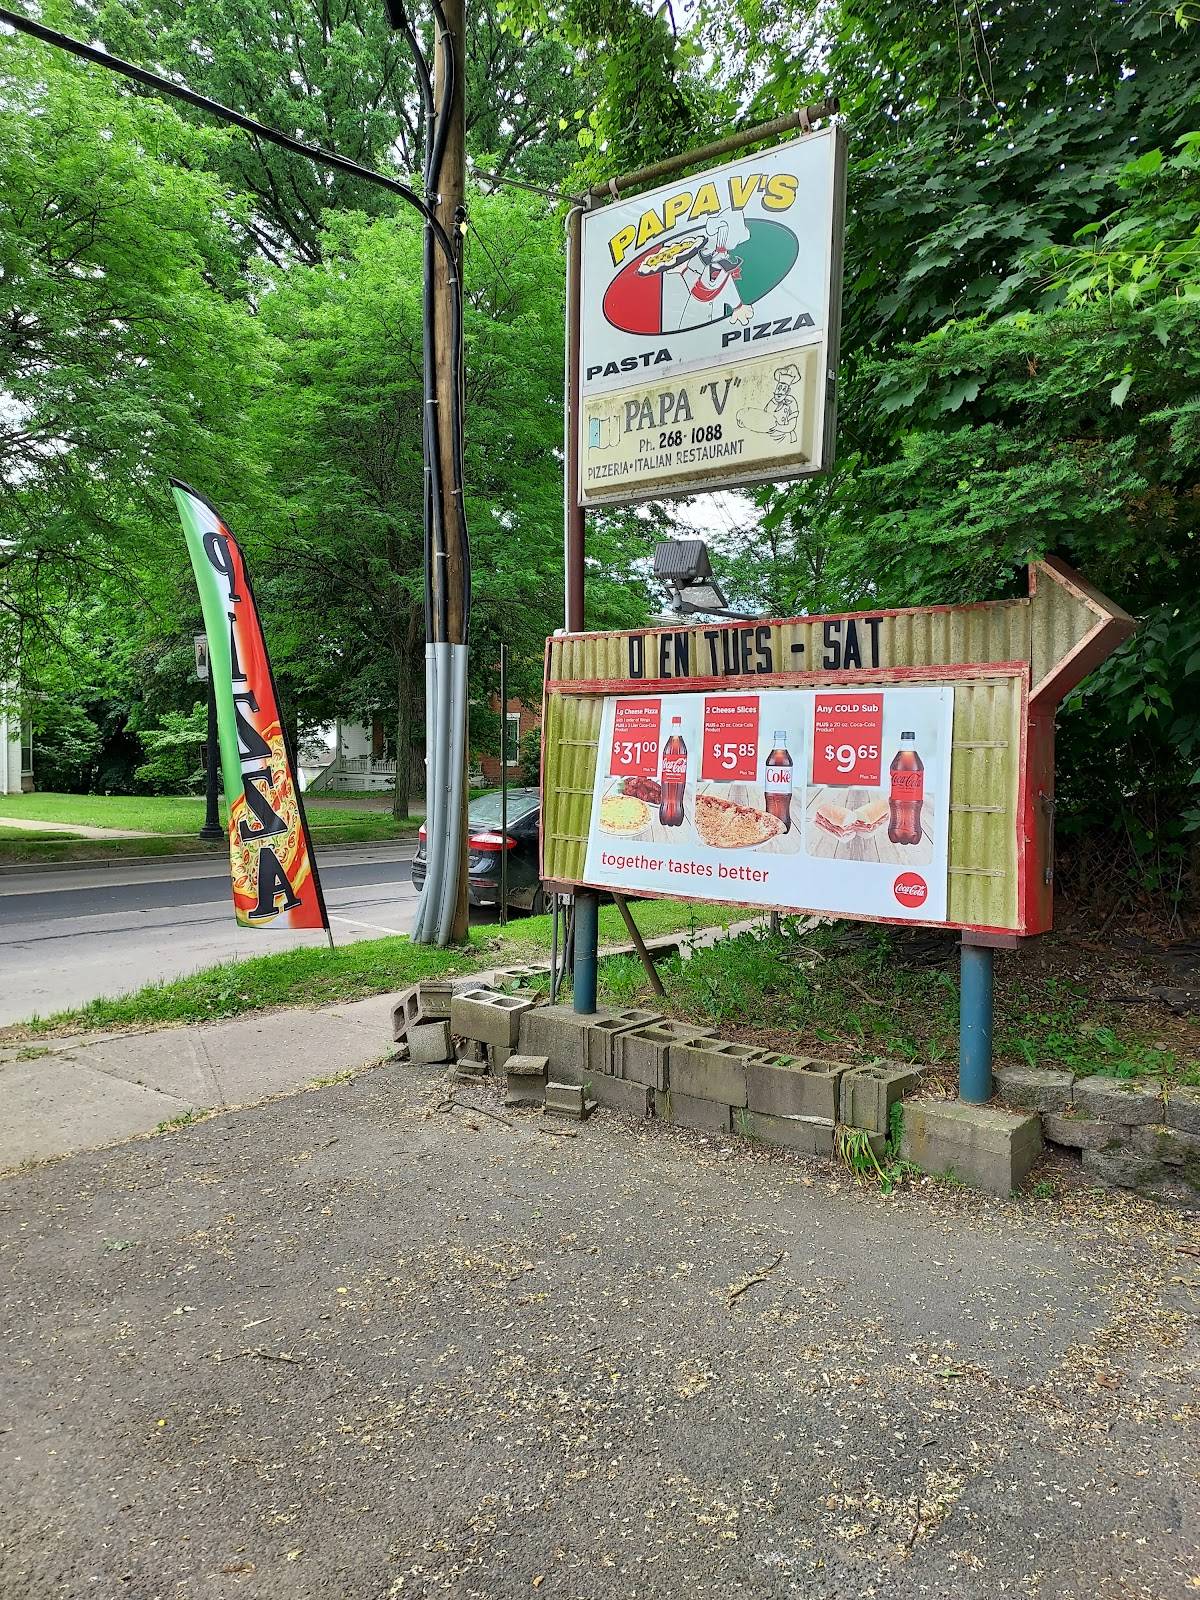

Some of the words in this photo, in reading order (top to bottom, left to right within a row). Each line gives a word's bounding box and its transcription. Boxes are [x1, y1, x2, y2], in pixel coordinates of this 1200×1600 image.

[608, 182, 722, 268] PAPA
[727, 173, 799, 213] V'S
[721, 312, 816, 348] PIZZA
[586, 348, 673, 381] PASTA
[623, 388, 694, 434] PAPA
[659, 423, 723, 449] 268-1088
[676, 439, 745, 465] RESTAURANT
[703, 625, 773, 677] TUES
[822, 616, 884, 671] SAT
[705, 706, 711, 714] 2
[711, 706, 736, 714] Cheese
[736, 705, 757, 714] Slices
[816, 704, 833, 714] Any
[834, 704, 860, 713] COLD
[861, 703, 879, 713] Sub
[766, 768, 791, 783] Coke
[601, 852, 664, 870] together
[668, 859, 713, 877] tastes
[717, 863, 769, 883] better
